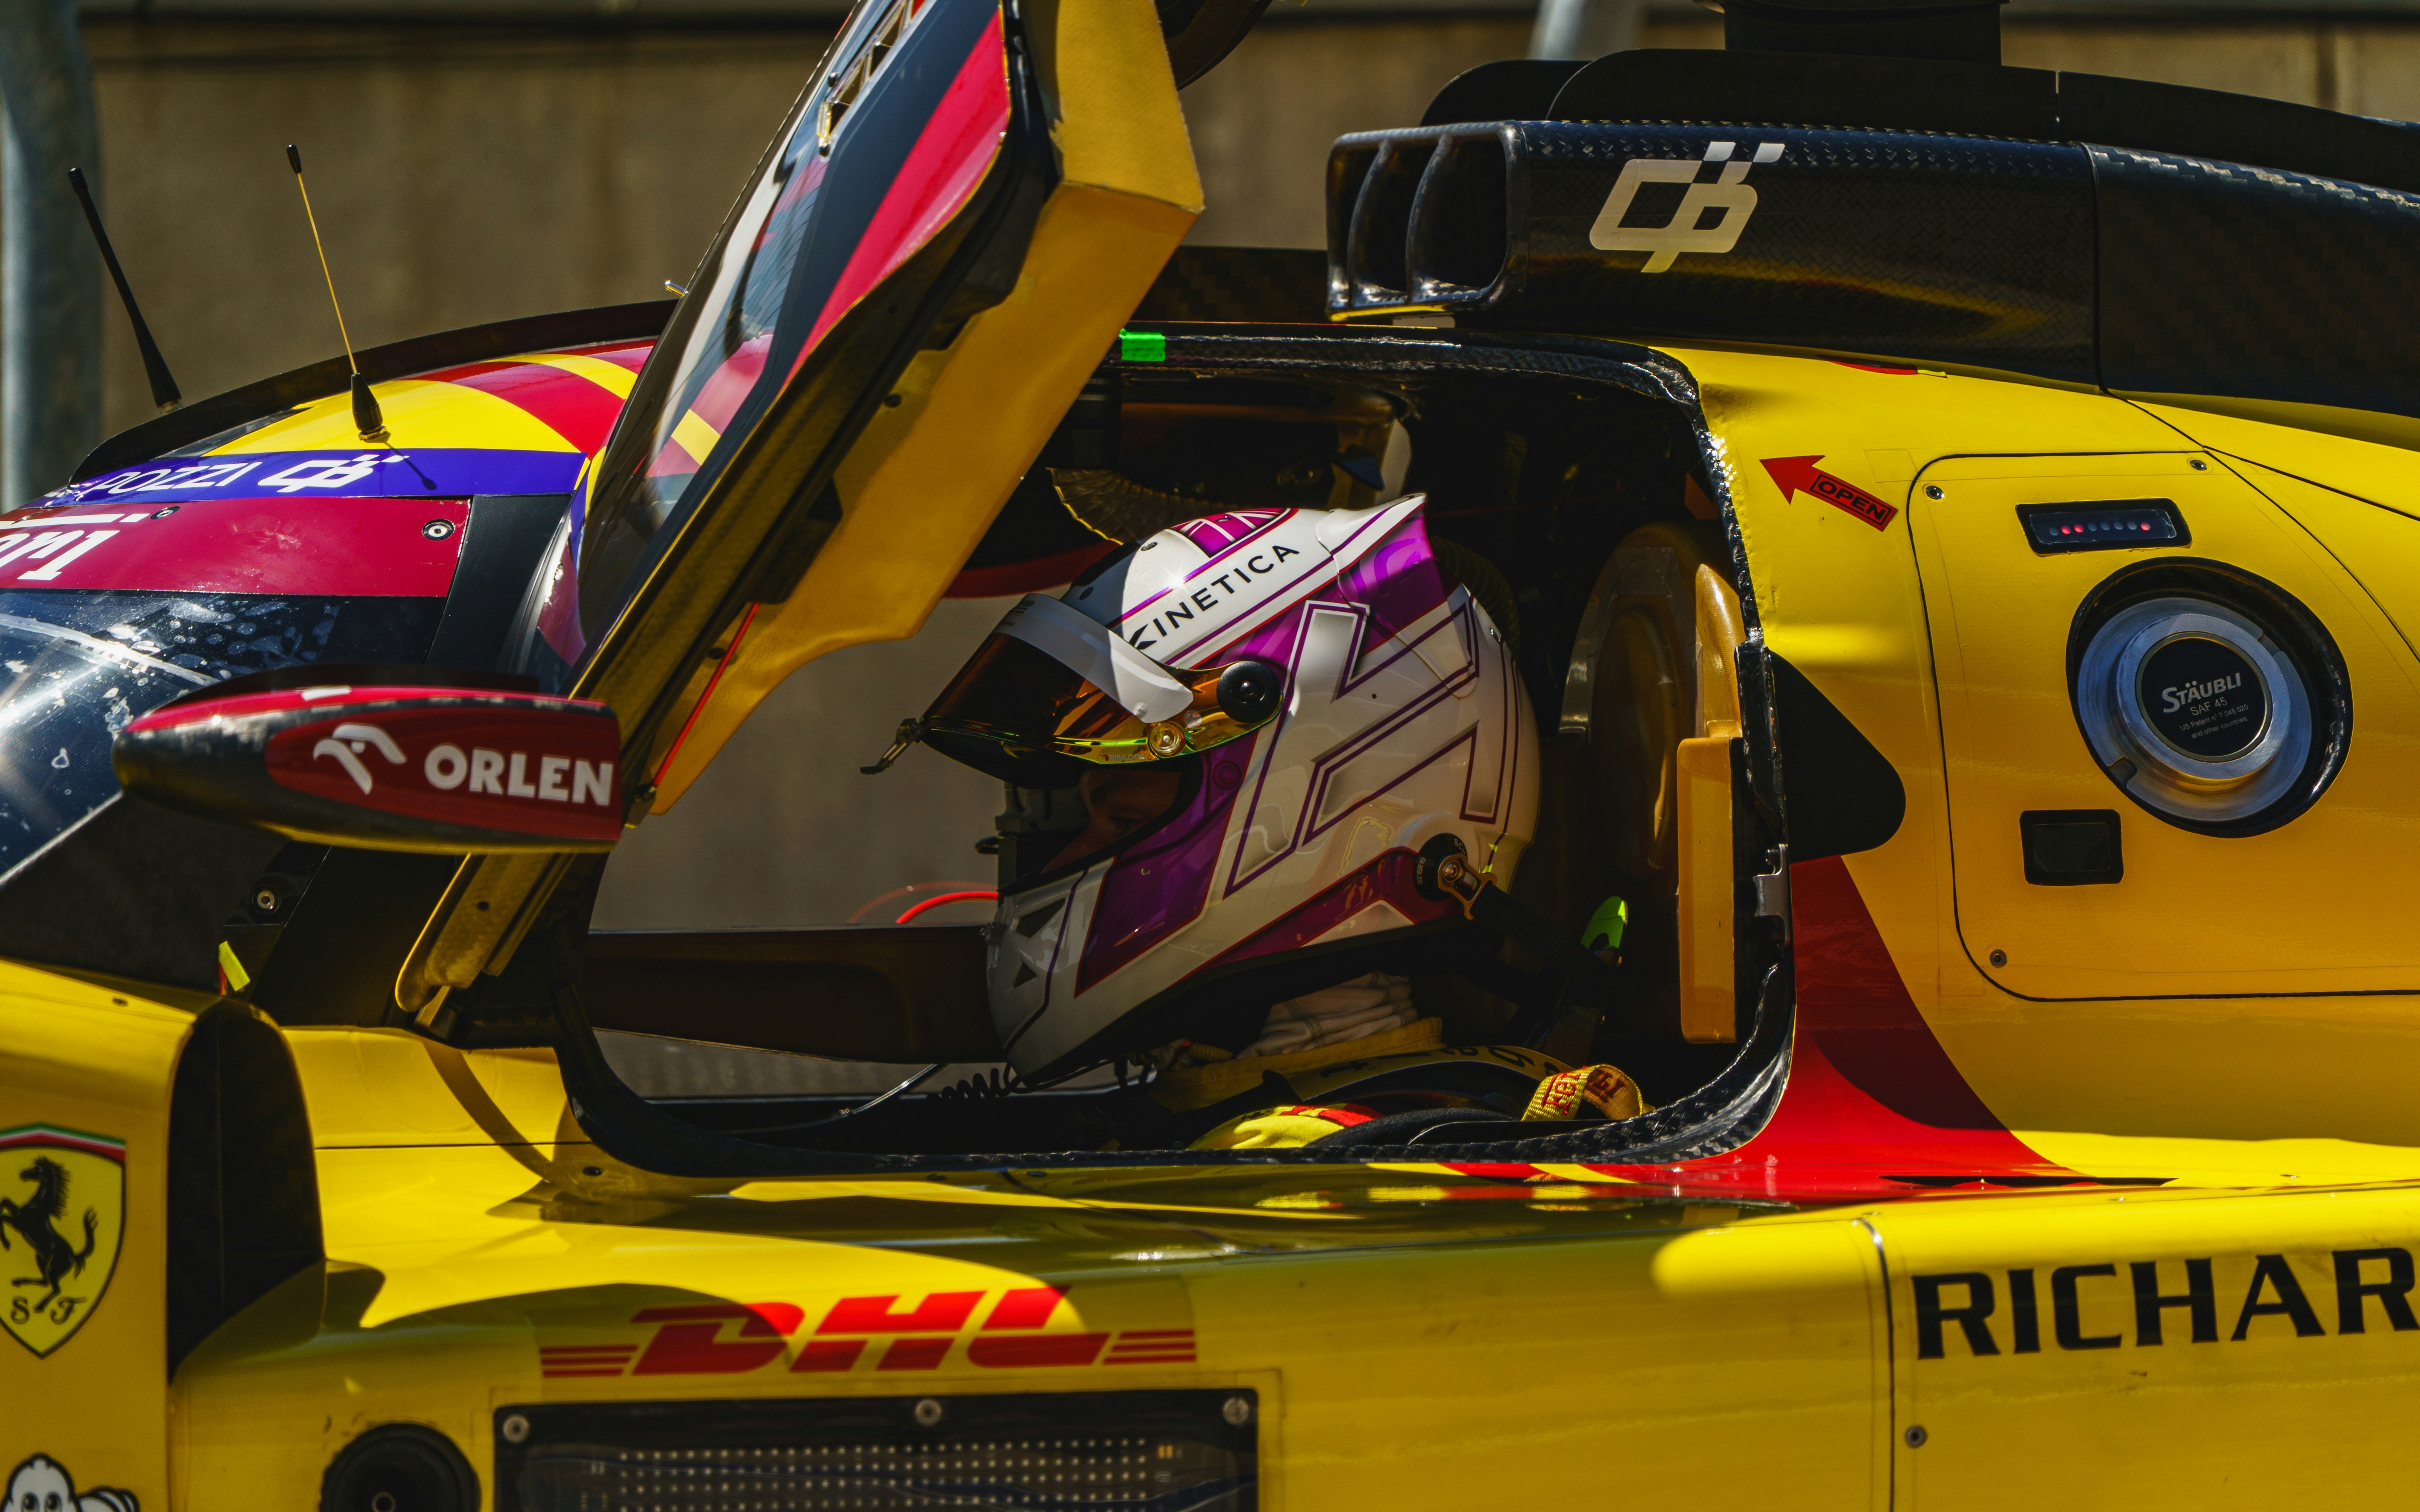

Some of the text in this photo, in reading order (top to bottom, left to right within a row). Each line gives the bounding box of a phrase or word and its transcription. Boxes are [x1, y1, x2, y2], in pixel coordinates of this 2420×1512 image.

[75, 461, 262, 498] POZZI
[1818, 481, 1886, 520] OPEN
[1129, 545, 1300, 650] KINETICA
[2162, 672, 2241, 713] STÄUBLI
[2191, 697, 2227, 715] SAF 45
[2191, 717, 2211, 727] Patent
[2237, 704, 2249, 712] 020
[2192, 716, 2248, 738] and other countries
[424, 744, 614, 806] ORLEN
[1911, 1247, 2420, 1360] RICHAR
[630, 1286, 1112, 1376] DHL
